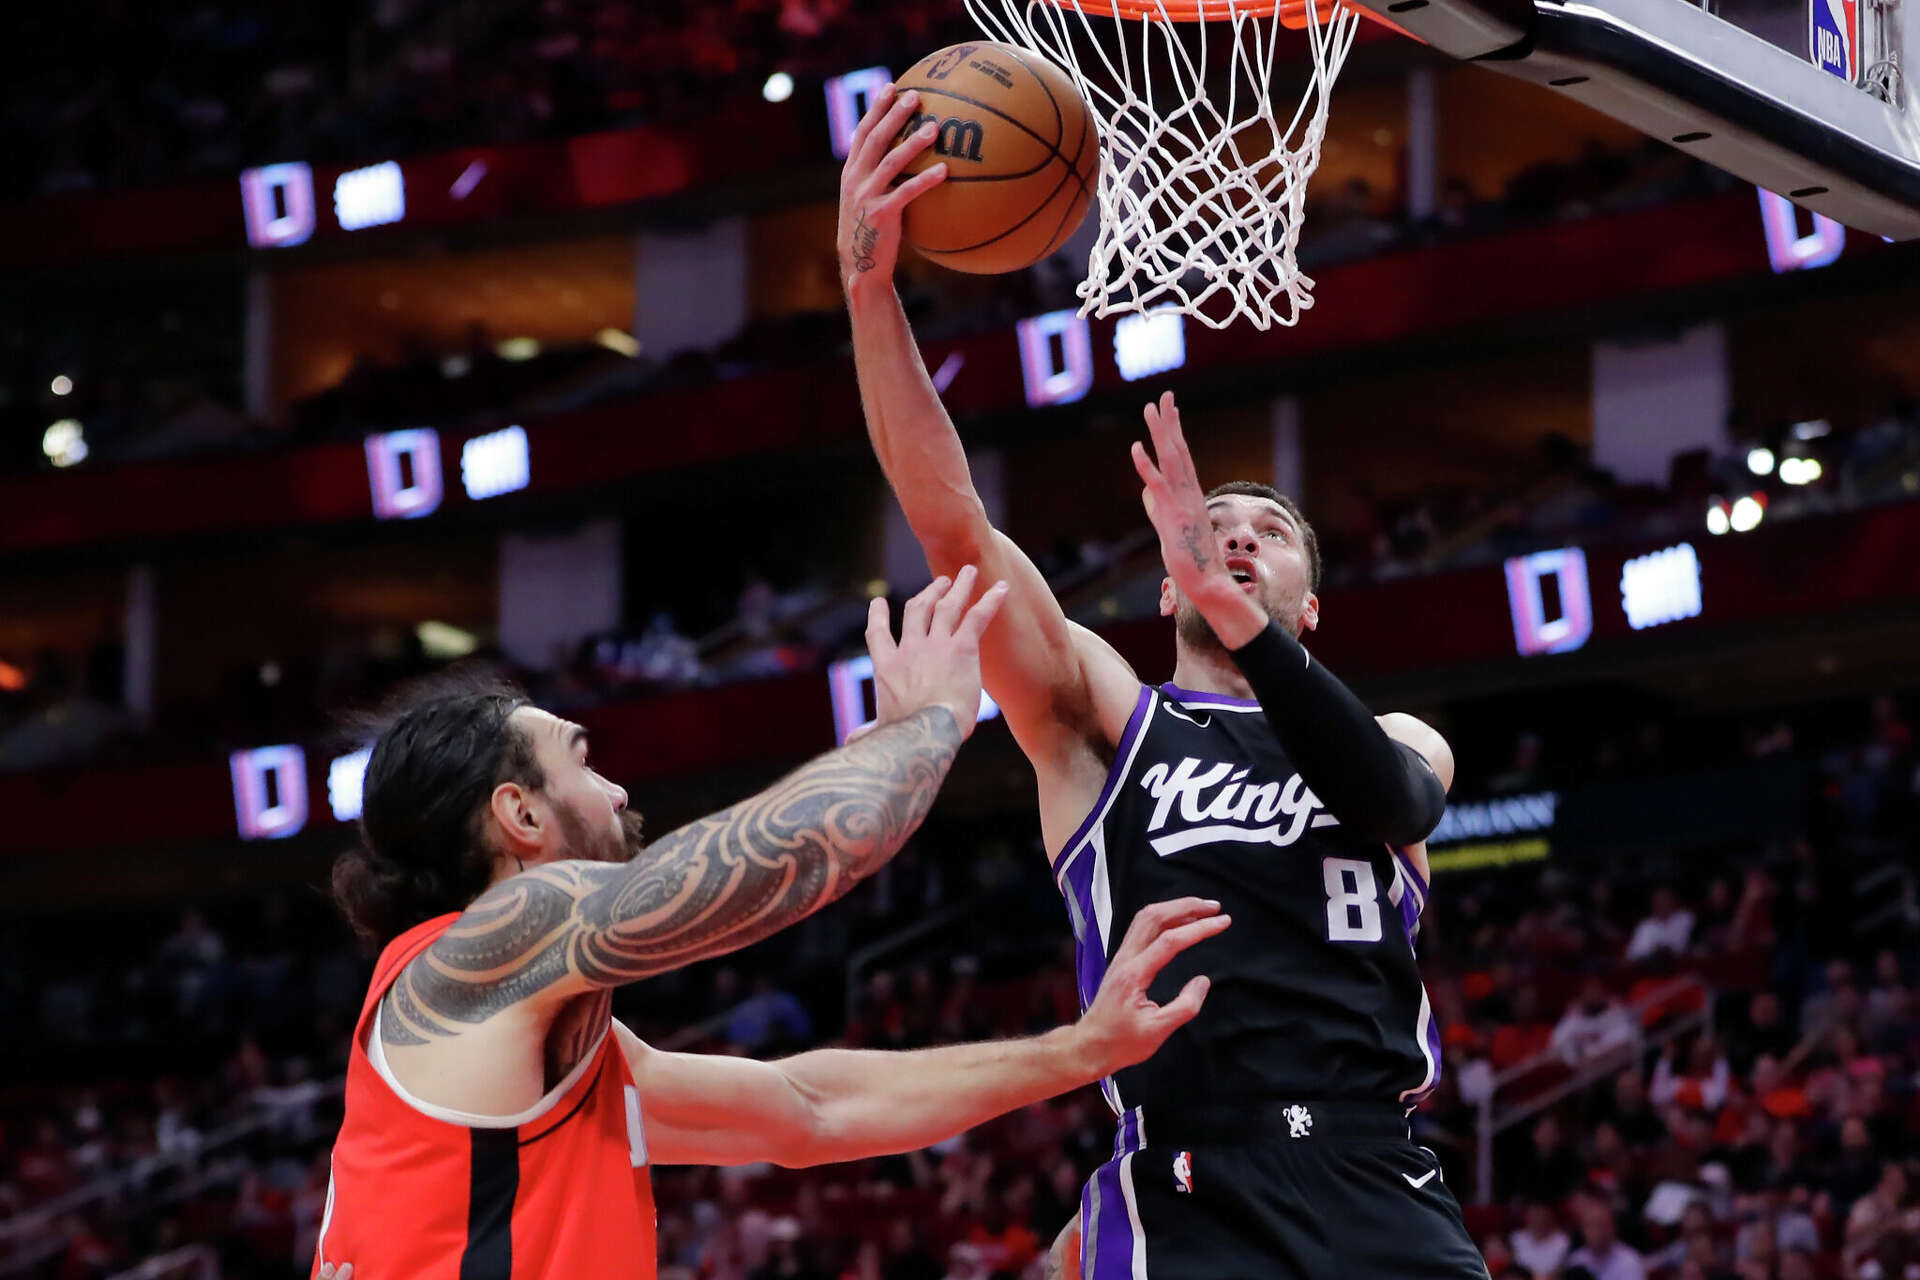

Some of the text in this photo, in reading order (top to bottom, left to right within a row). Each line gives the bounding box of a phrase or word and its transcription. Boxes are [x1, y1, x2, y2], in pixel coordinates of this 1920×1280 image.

[1817, 25, 1841, 69] NBA
[1140, 757, 1330, 857] King
[1323, 857, 1382, 941] 8
